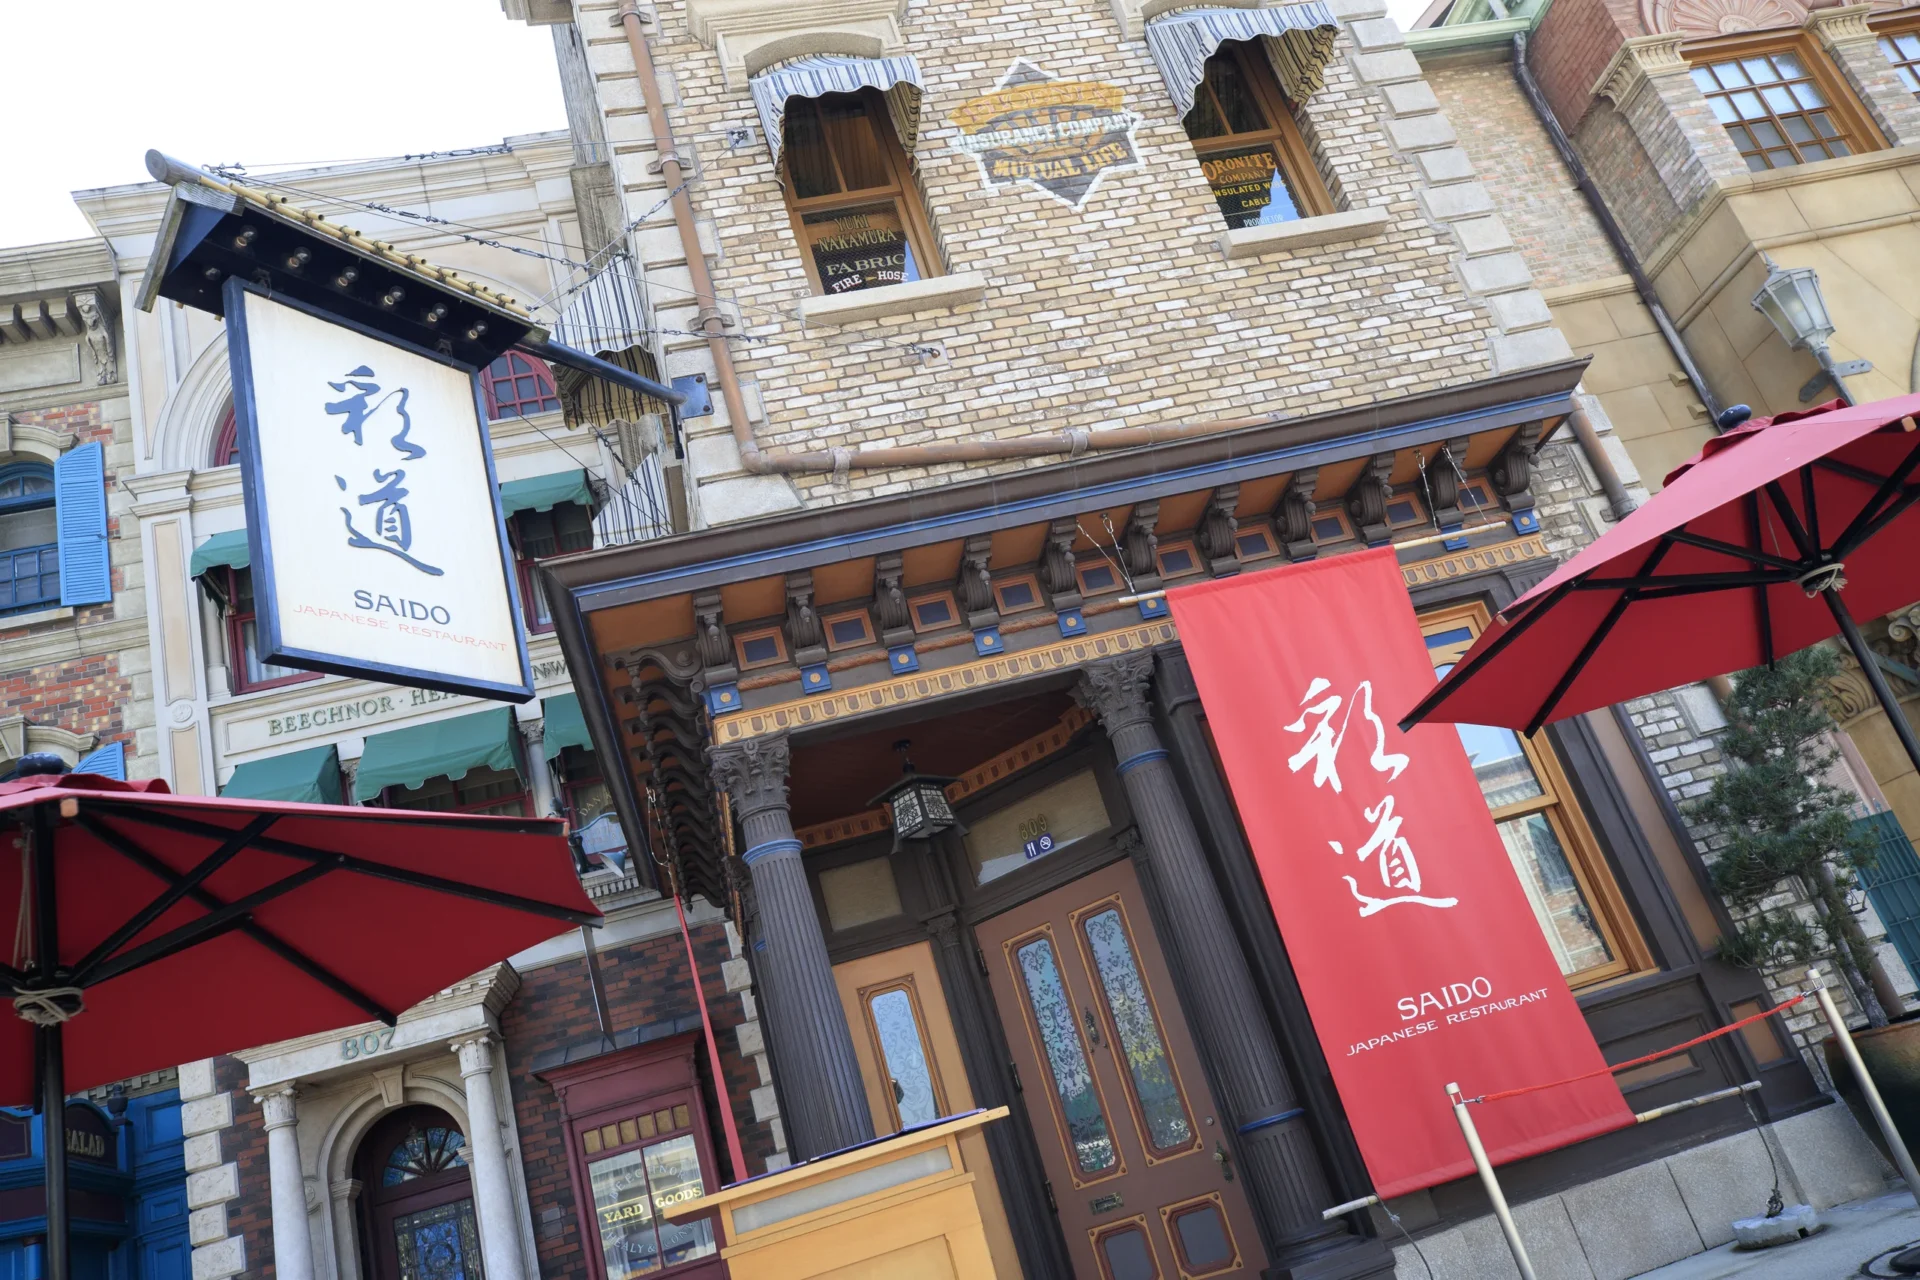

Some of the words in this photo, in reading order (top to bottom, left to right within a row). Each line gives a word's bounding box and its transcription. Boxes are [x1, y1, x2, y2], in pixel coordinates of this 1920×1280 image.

[958, 123, 1055, 152] INSURANCE
[1058, 113, 1134, 139] COMPANY
[992, 158, 1082, 180] MUTUAL
[1080, 142, 1128, 173] LIFE
[1201, 152, 1277, 180] ORONITE
[1219, 169, 1268, 185] COMPANY
[1211, 183, 1261, 197] NSULATED
[1241, 196, 1272, 208] CABLE
[834, 213, 871, 232] YUKI
[1243, 213, 1284, 227] PROPRIETOR
[817, 227, 898, 253] NAKAMURA
[826, 253, 906, 276] FABRIC
[832, 274, 863, 293] FIRE
[877, 270, 909, 282] HOSE
[324, 365, 445, 577] 彩道
[353, 589, 451, 626] SAIDO
[293, 604, 390, 630] JAPANESE
[398, 623, 508, 652] RESTAURANT
[268, 694, 396, 737] BEECHNOR
[1283, 677, 1459, 917] 彩道
[1019, 814, 1047, 841] 809
[1397, 976, 1492, 1021] SAIDO
[1347, 1019, 1439, 1056] JAPANESE
[1446, 987, 1549, 1025] RESTAURANT
[342, 1027, 396, 1060] 807
[609, 1164, 684, 1200] BEECHNOR
[604, 1203, 644, 1223] YARD
[655, 1186, 702, 1209] GOODS
[606, 1231, 643, 1254] HEALY
